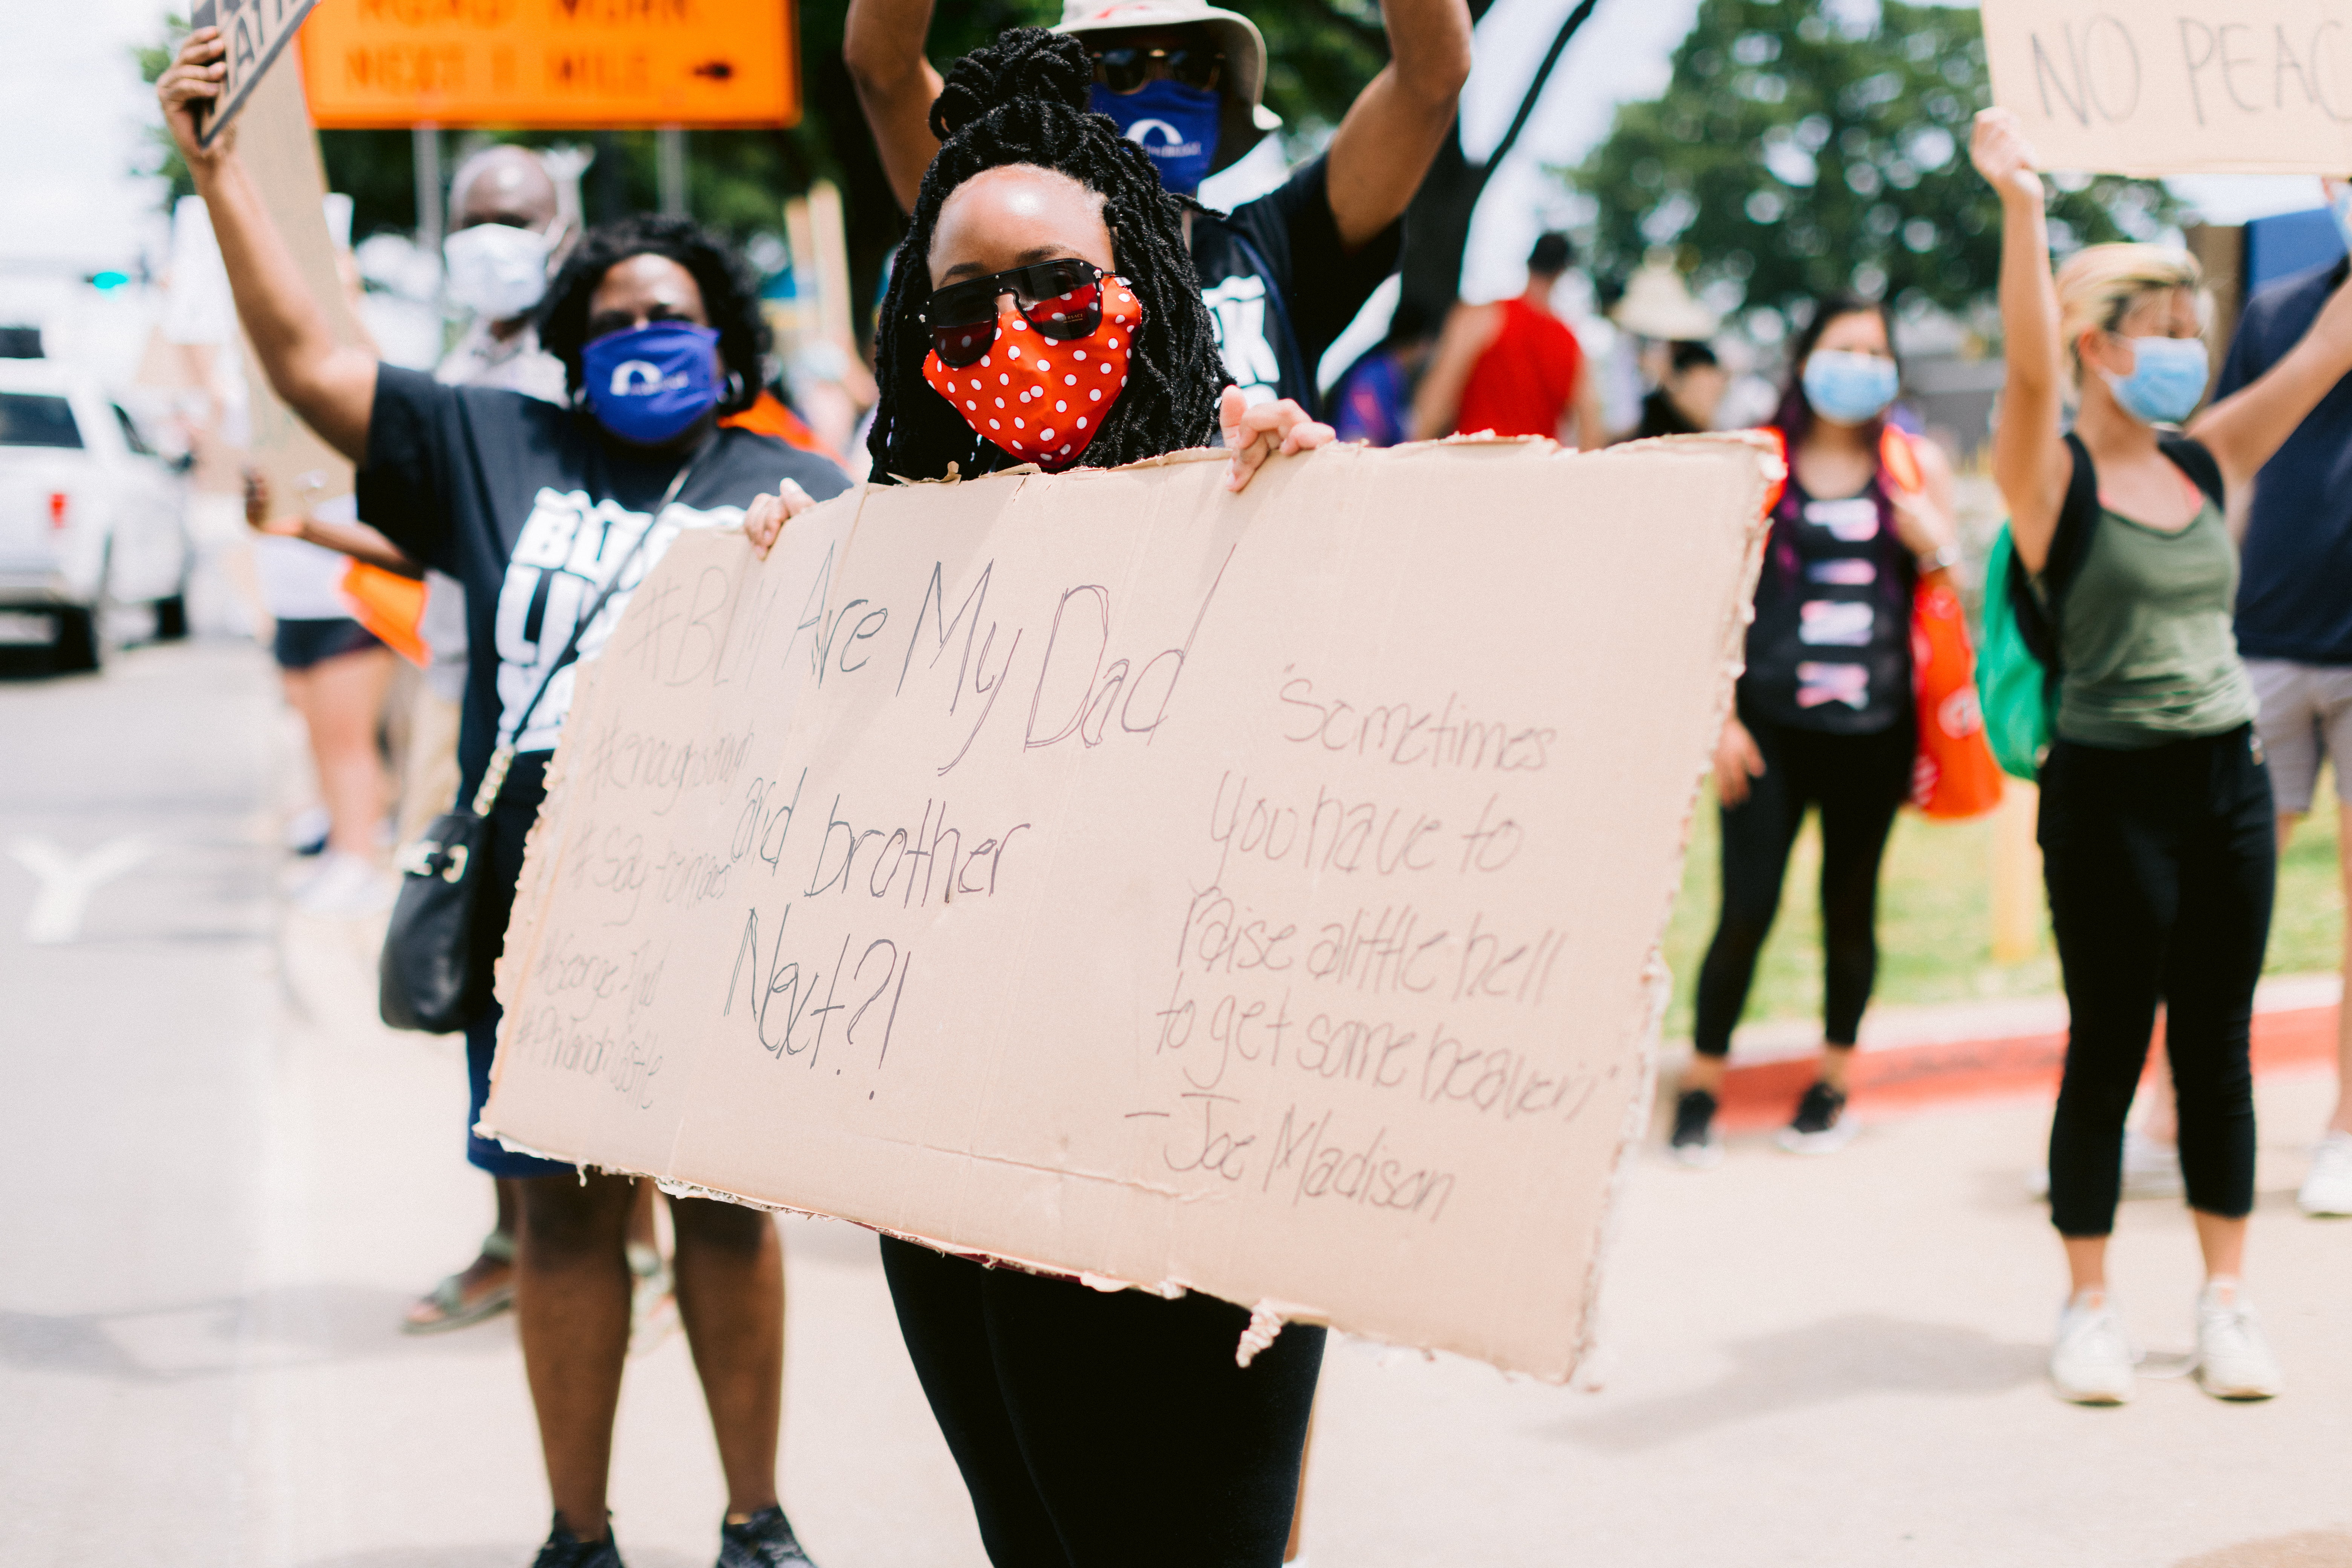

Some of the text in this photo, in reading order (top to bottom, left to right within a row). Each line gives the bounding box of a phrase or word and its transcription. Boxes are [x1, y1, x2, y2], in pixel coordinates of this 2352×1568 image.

[2032, 12, 2141, 127] NO
[781, 540, 889, 690] Are
[895, 558, 1023, 777] My
[1023, 543, 1236, 753] Dad
[730, 766, 1031, 908] and brother
[1304, 784, 1442, 876] have
[1461, 792, 1523, 874] to
[723, 902, 911, 1101] Next?!
[1450, 910, 1568, 1007] hell
[1155, 971, 1196, 1055] to
[1182, 986, 1293, 1090] get
[1296, 1014, 1417, 1087] some
[1262, 1104, 1456, 1223] Madison
